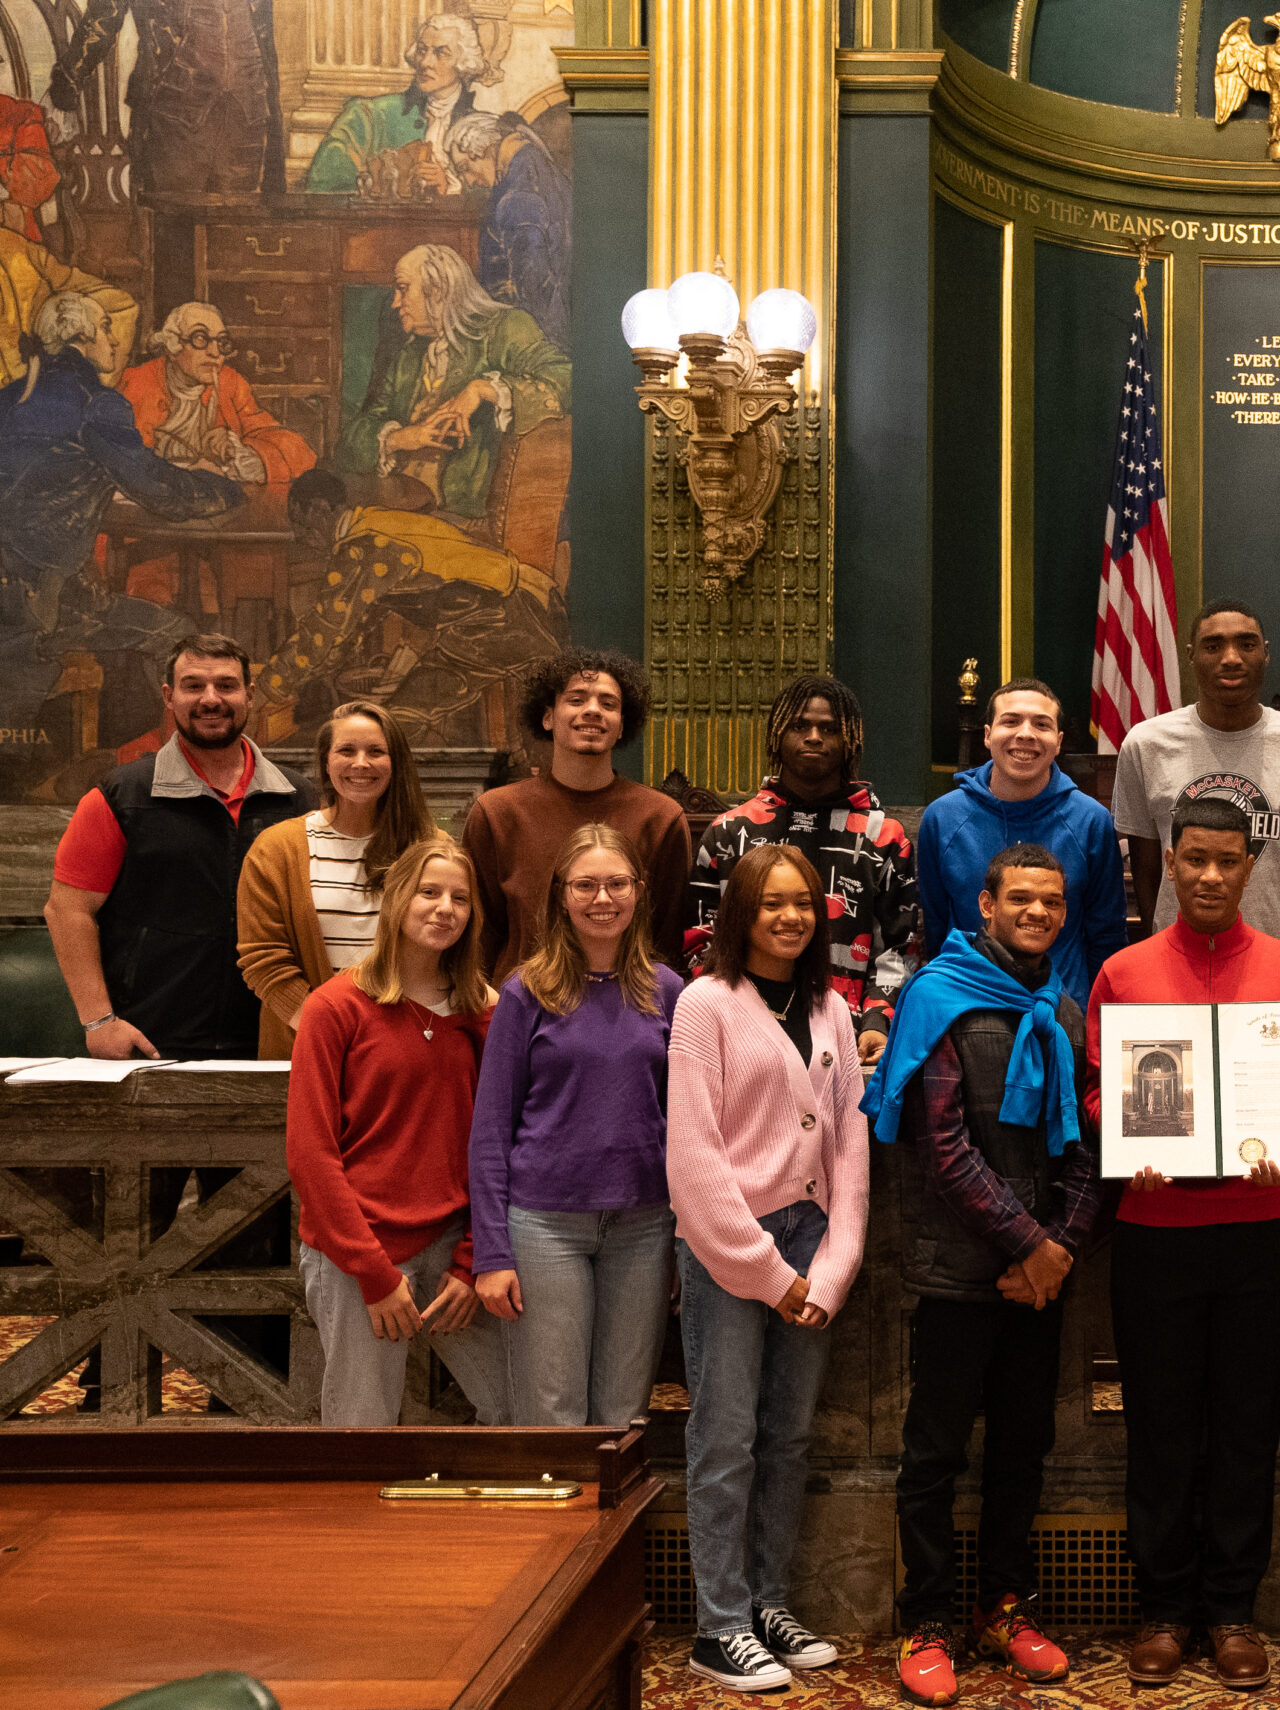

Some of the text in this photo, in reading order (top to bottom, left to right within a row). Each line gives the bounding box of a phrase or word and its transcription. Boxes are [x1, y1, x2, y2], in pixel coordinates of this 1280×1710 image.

[1024, 190, 1041, 213] IS
[1048, 200, 1084, 225] THE
[1090, 209, 1164, 236] MEANS
[1171, 220, 1200, 240] OF
[1237, 373, 1275, 386] TAKE
[1216, 391, 1248, 404] HOW
[1251, 392, 1270, 405] HE
[1185, 776, 1260, 799] McCASKEY
[1246, 812, 1280, 839] IELD
